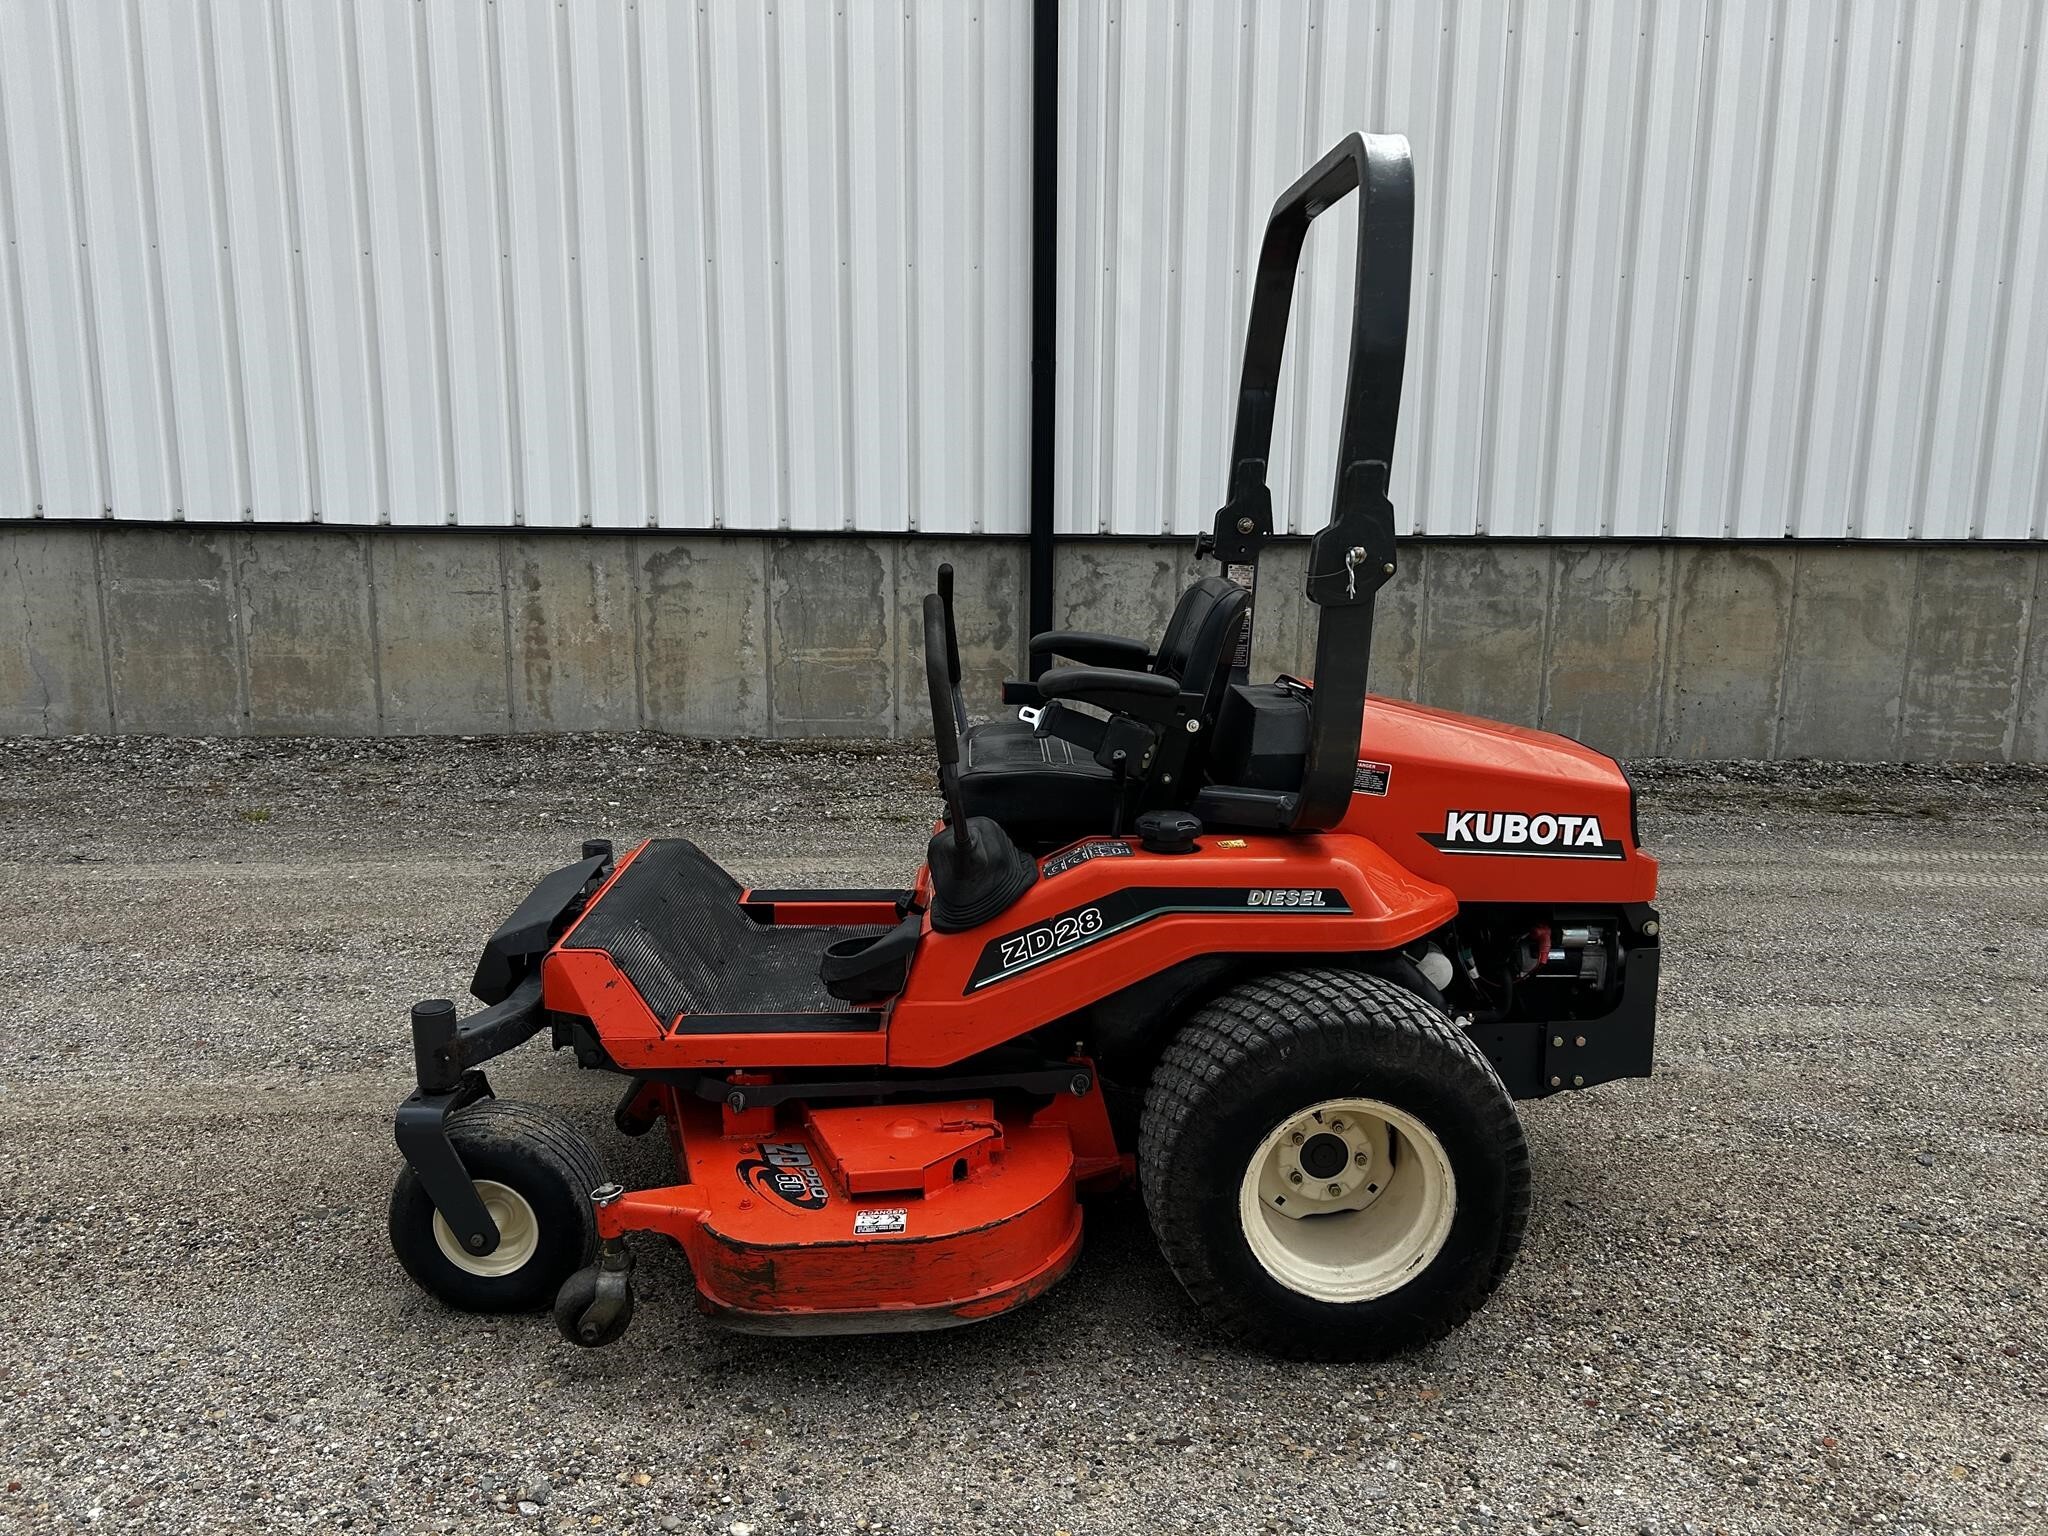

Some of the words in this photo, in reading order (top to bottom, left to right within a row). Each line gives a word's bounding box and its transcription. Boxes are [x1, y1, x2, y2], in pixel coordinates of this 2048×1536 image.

[1446, 812, 1604, 847] KUBOTA
[1247, 889, 1326, 906] DIESEL
[1001, 908, 1103, 968] ZD28
[762, 1143, 812, 1166] ZD
[801, 1167, 829, 1198] PRO
[775, 1173, 807, 1192] 60
